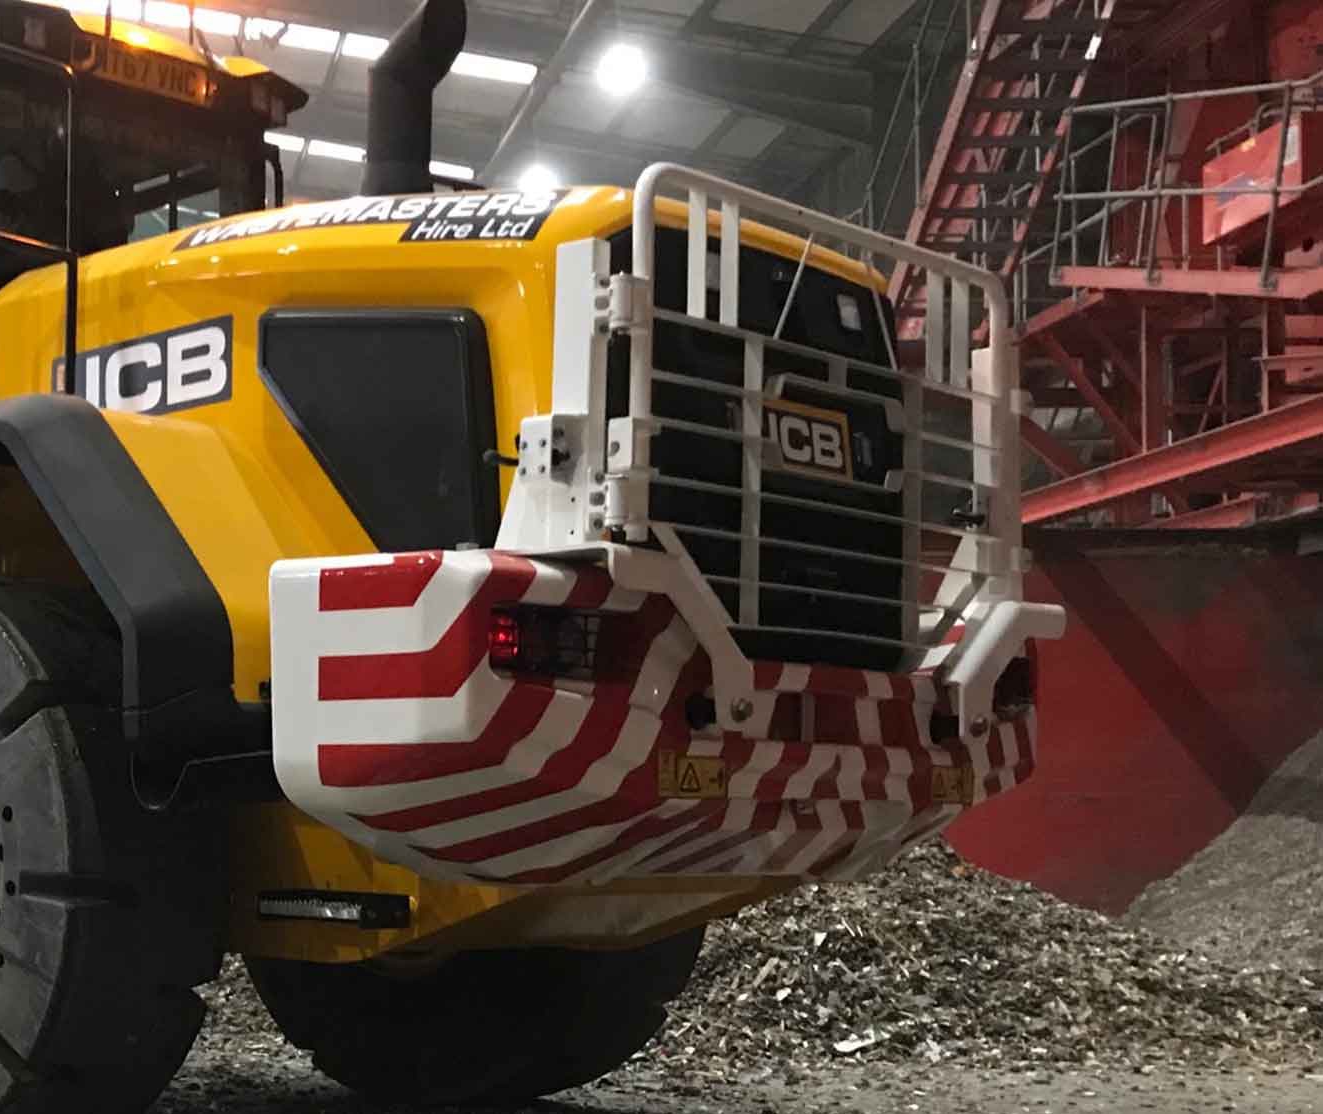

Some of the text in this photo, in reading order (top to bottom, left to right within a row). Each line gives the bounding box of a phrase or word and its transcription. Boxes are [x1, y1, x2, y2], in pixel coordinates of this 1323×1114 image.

[189, 191, 557, 248] WASTEMASTERS
[411, 216, 535, 240] Hire Ltd
